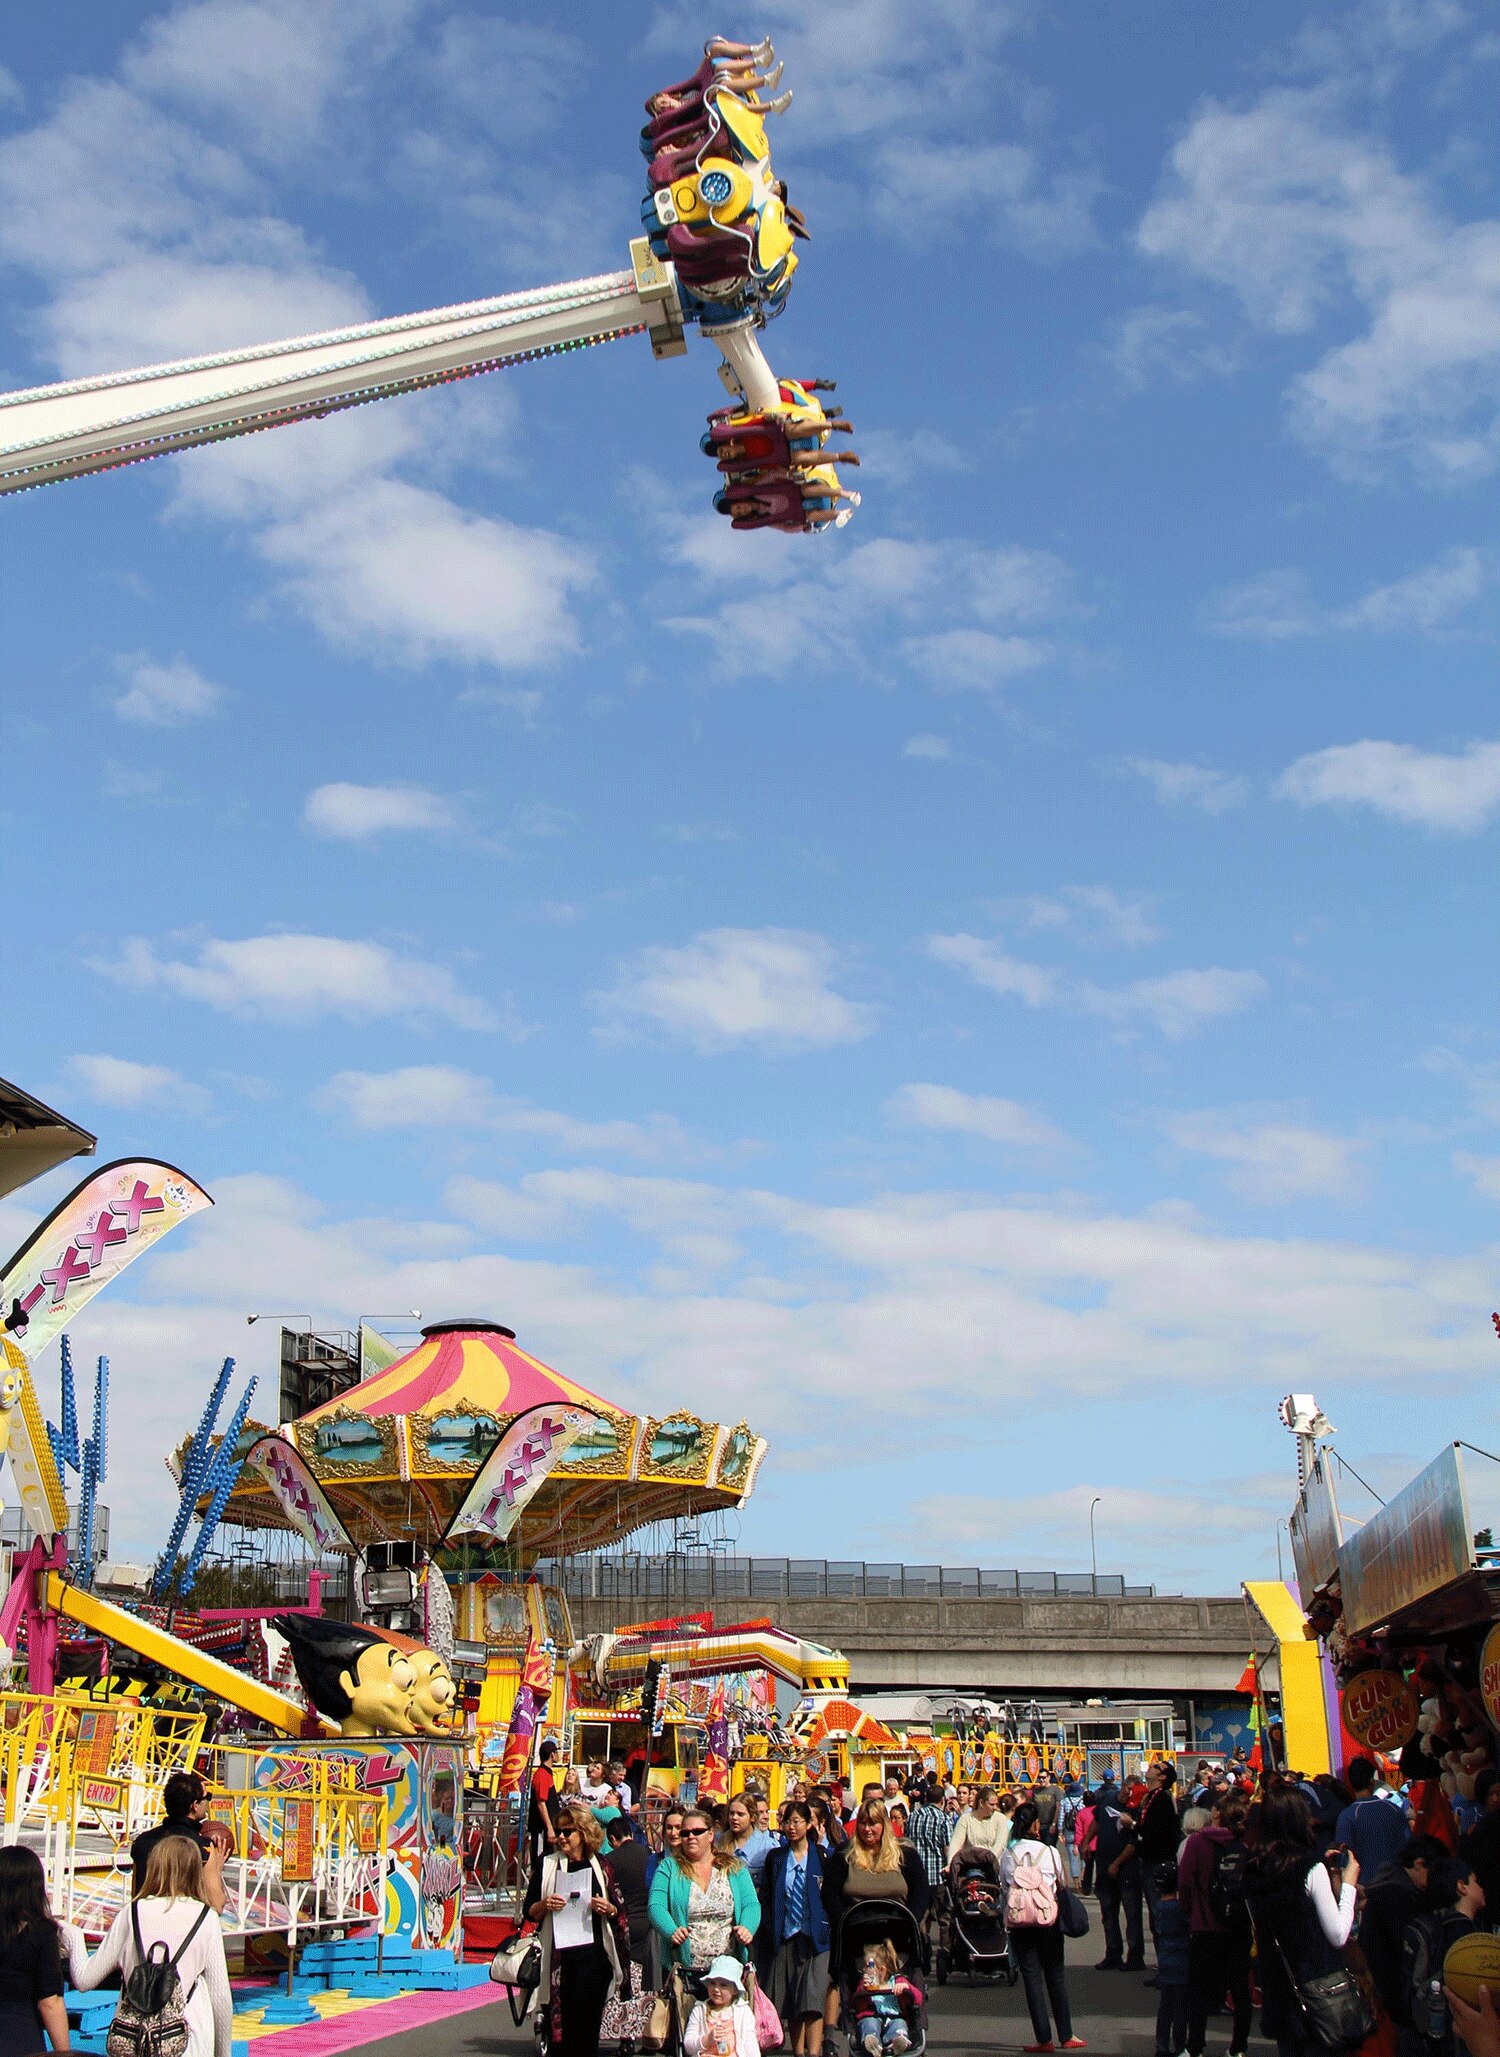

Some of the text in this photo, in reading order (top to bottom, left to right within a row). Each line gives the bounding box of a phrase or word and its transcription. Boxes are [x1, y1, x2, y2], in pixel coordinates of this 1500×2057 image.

[266, 1446, 329, 1548] XXXL
[478, 1418, 567, 1530] XXXL
[1347, 1675, 1393, 1722] FUN
[1366, 1694, 1413, 1748] GUN
[85, 1783, 118, 1804] ENTRY
